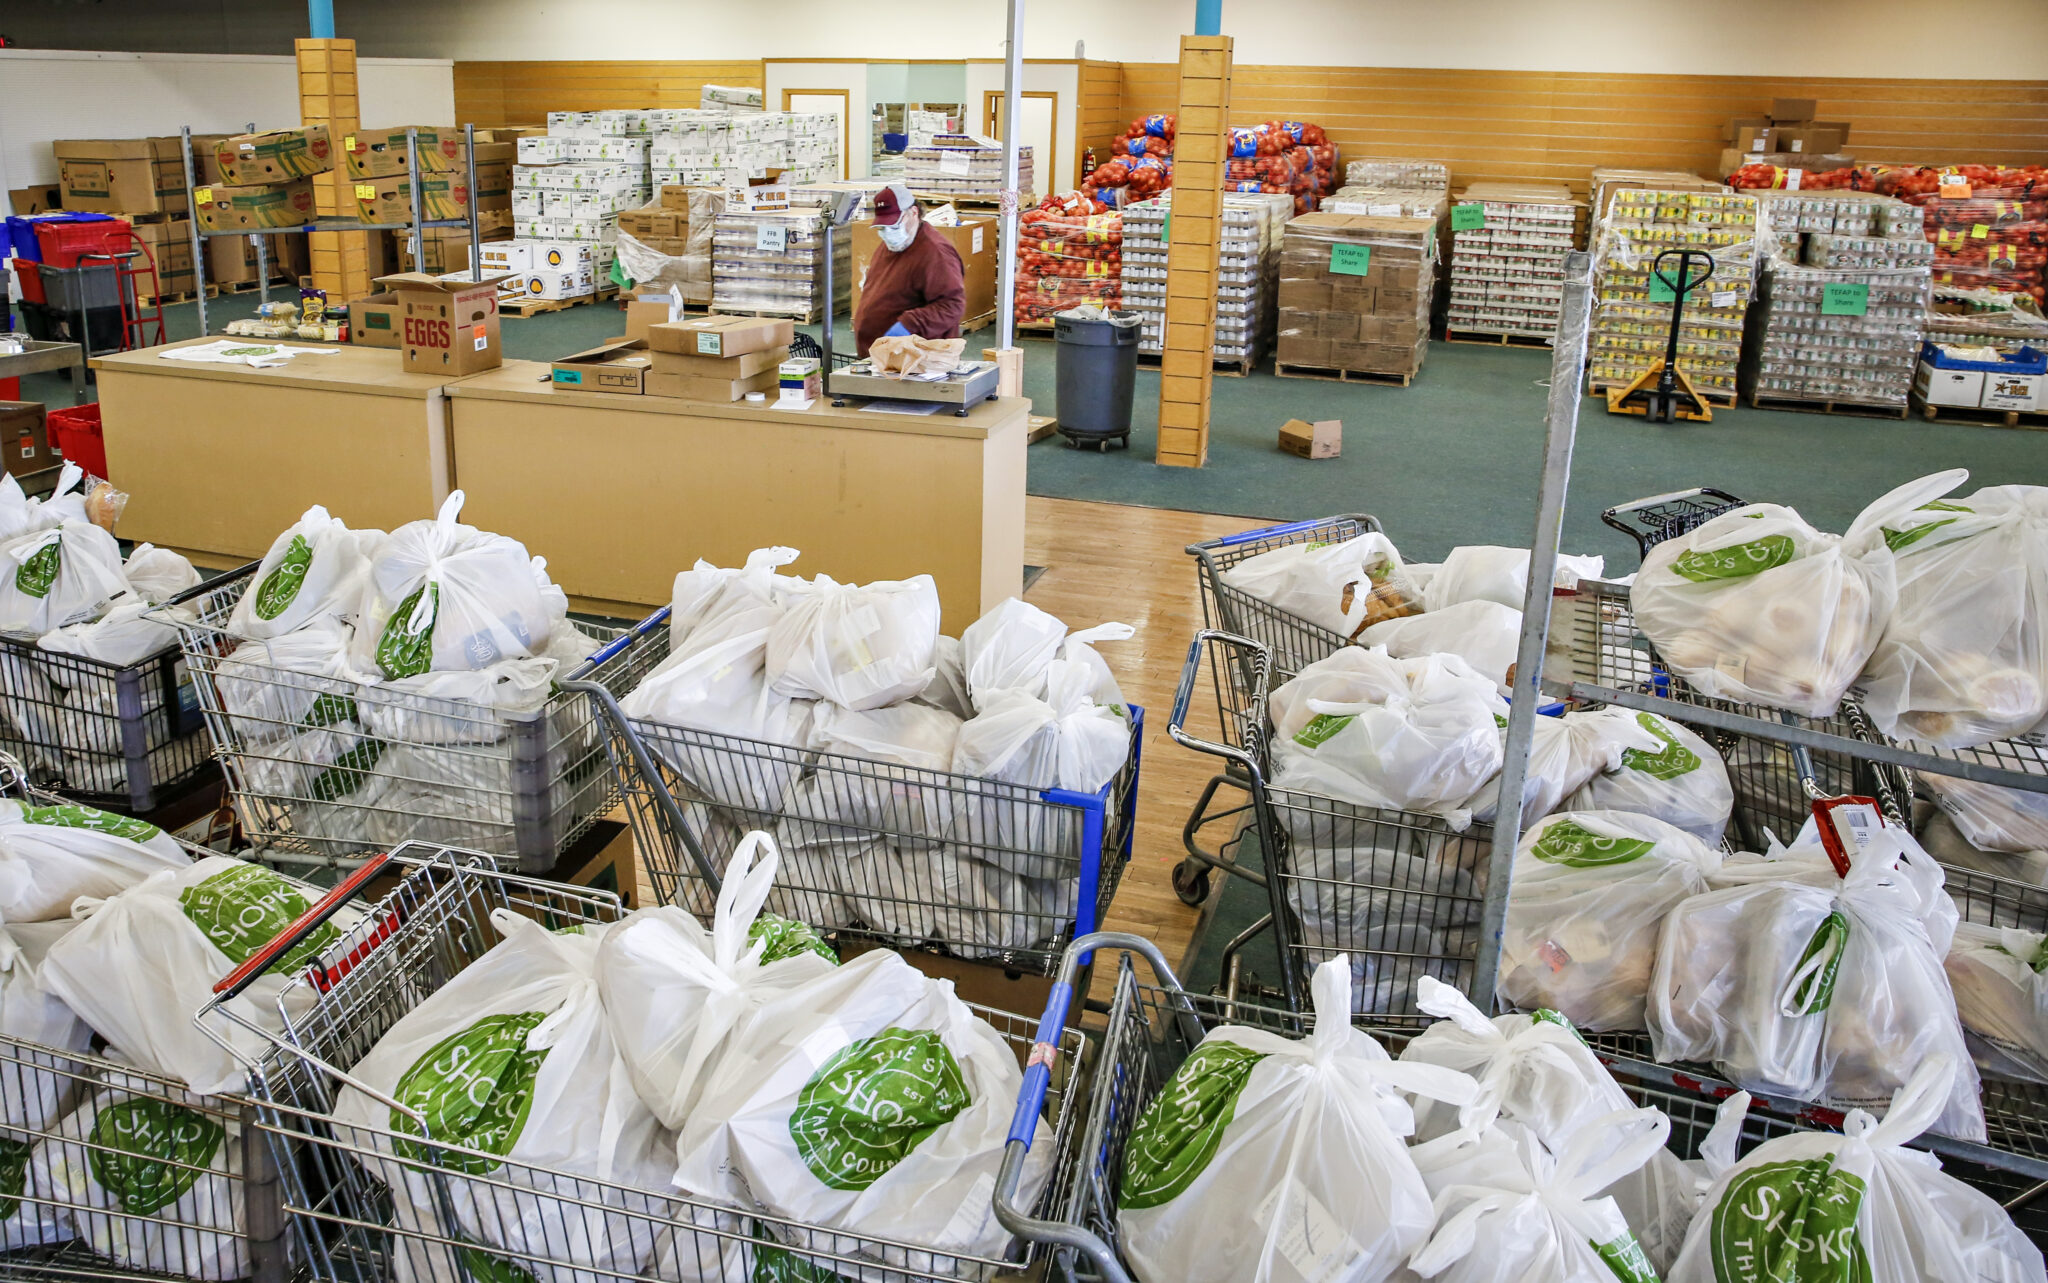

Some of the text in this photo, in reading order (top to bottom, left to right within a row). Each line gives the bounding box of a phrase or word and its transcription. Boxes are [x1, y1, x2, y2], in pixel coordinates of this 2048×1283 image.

[1830, 289, 1852, 297] TEFAP
[404, 317, 451, 349] EGGS
[209, 885, 300, 947] SHOPK
[902, 1086, 926, 1104] EST
[812, 1105, 841, 1152] THAT
